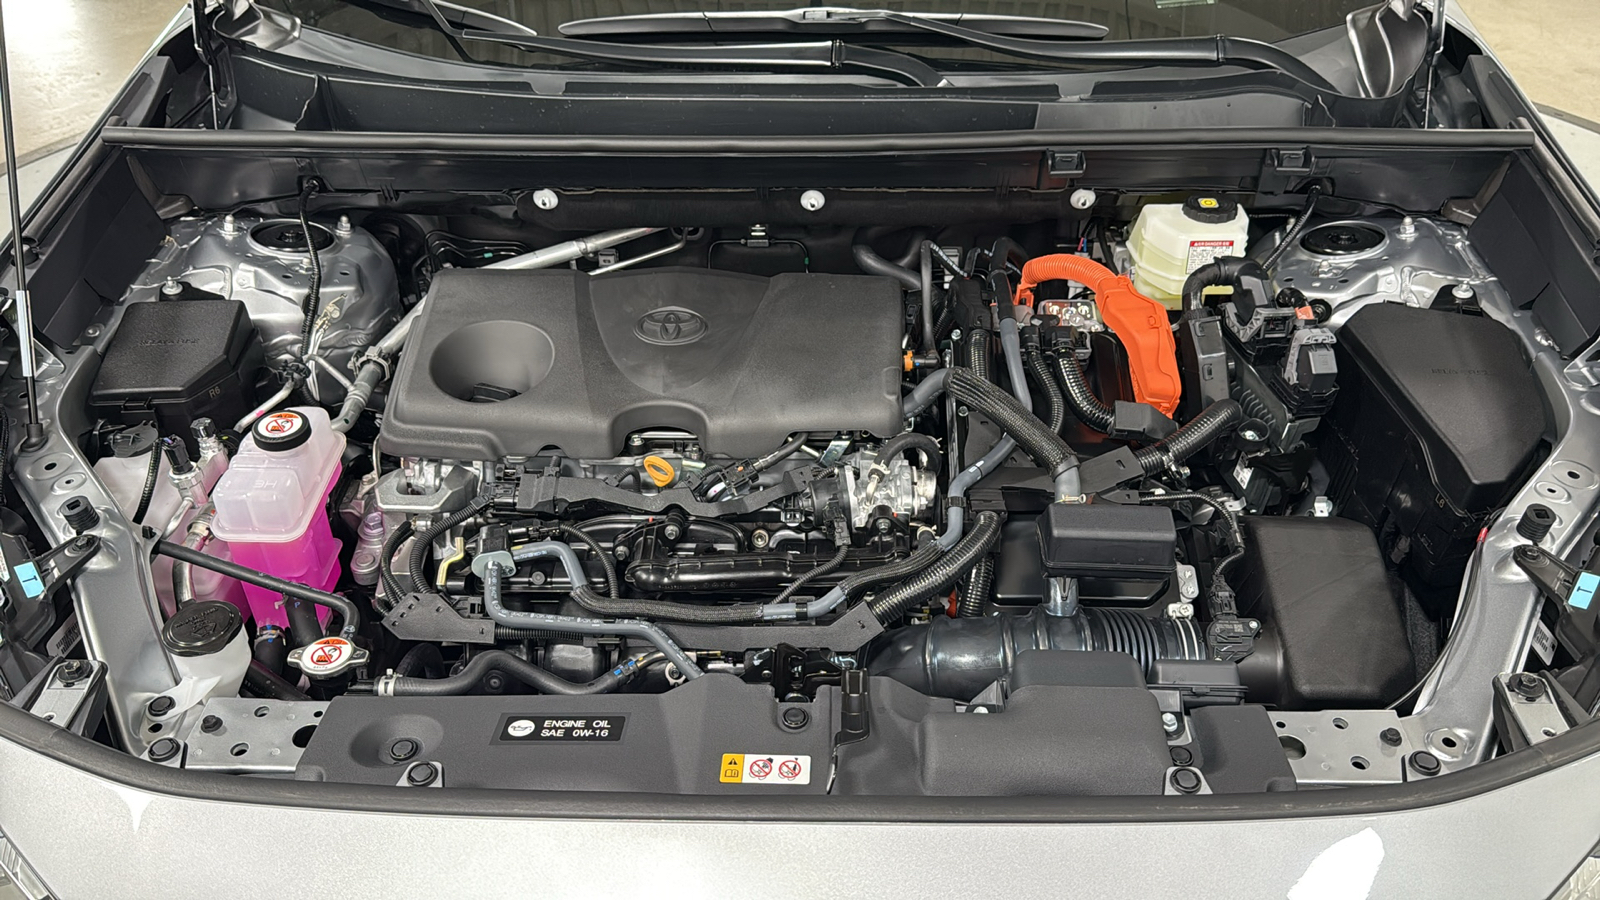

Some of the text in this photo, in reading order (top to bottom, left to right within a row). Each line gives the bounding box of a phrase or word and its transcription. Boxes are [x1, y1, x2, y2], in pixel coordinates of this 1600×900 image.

[209, 386, 221, 398] R6
[543, 719, 611, 728] ENGINE OIL
[540, 729, 609, 737] SAE 0W-16
